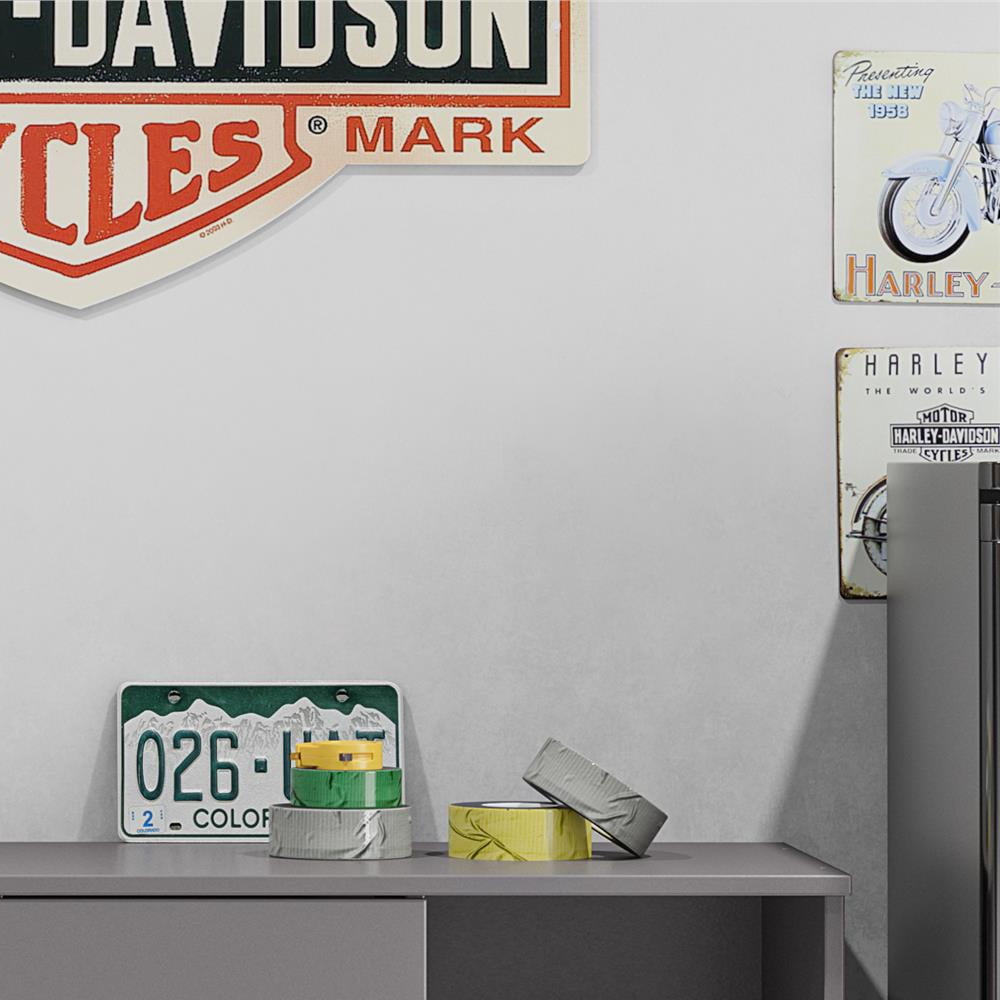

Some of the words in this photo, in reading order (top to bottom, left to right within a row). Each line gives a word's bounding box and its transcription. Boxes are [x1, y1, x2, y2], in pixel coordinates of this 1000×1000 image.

[843, 60, 934, 86] Presenting
[853, 84, 882, 100] THE
[887, 84, 925, 100] NEW
[868, 104, 909, 119] 1958
[346, 116, 545, 153] MARK
[865, 353, 988, 376] HARLEY
[865, 387, 892, 395] THE
[909, 386, 986, 395] WORLD'S
[922, 407, 967, 423] MOTOR
[894, 428, 999, 444] HARLEY-DAVIDSON
[142, 810, 154, 828] 2
